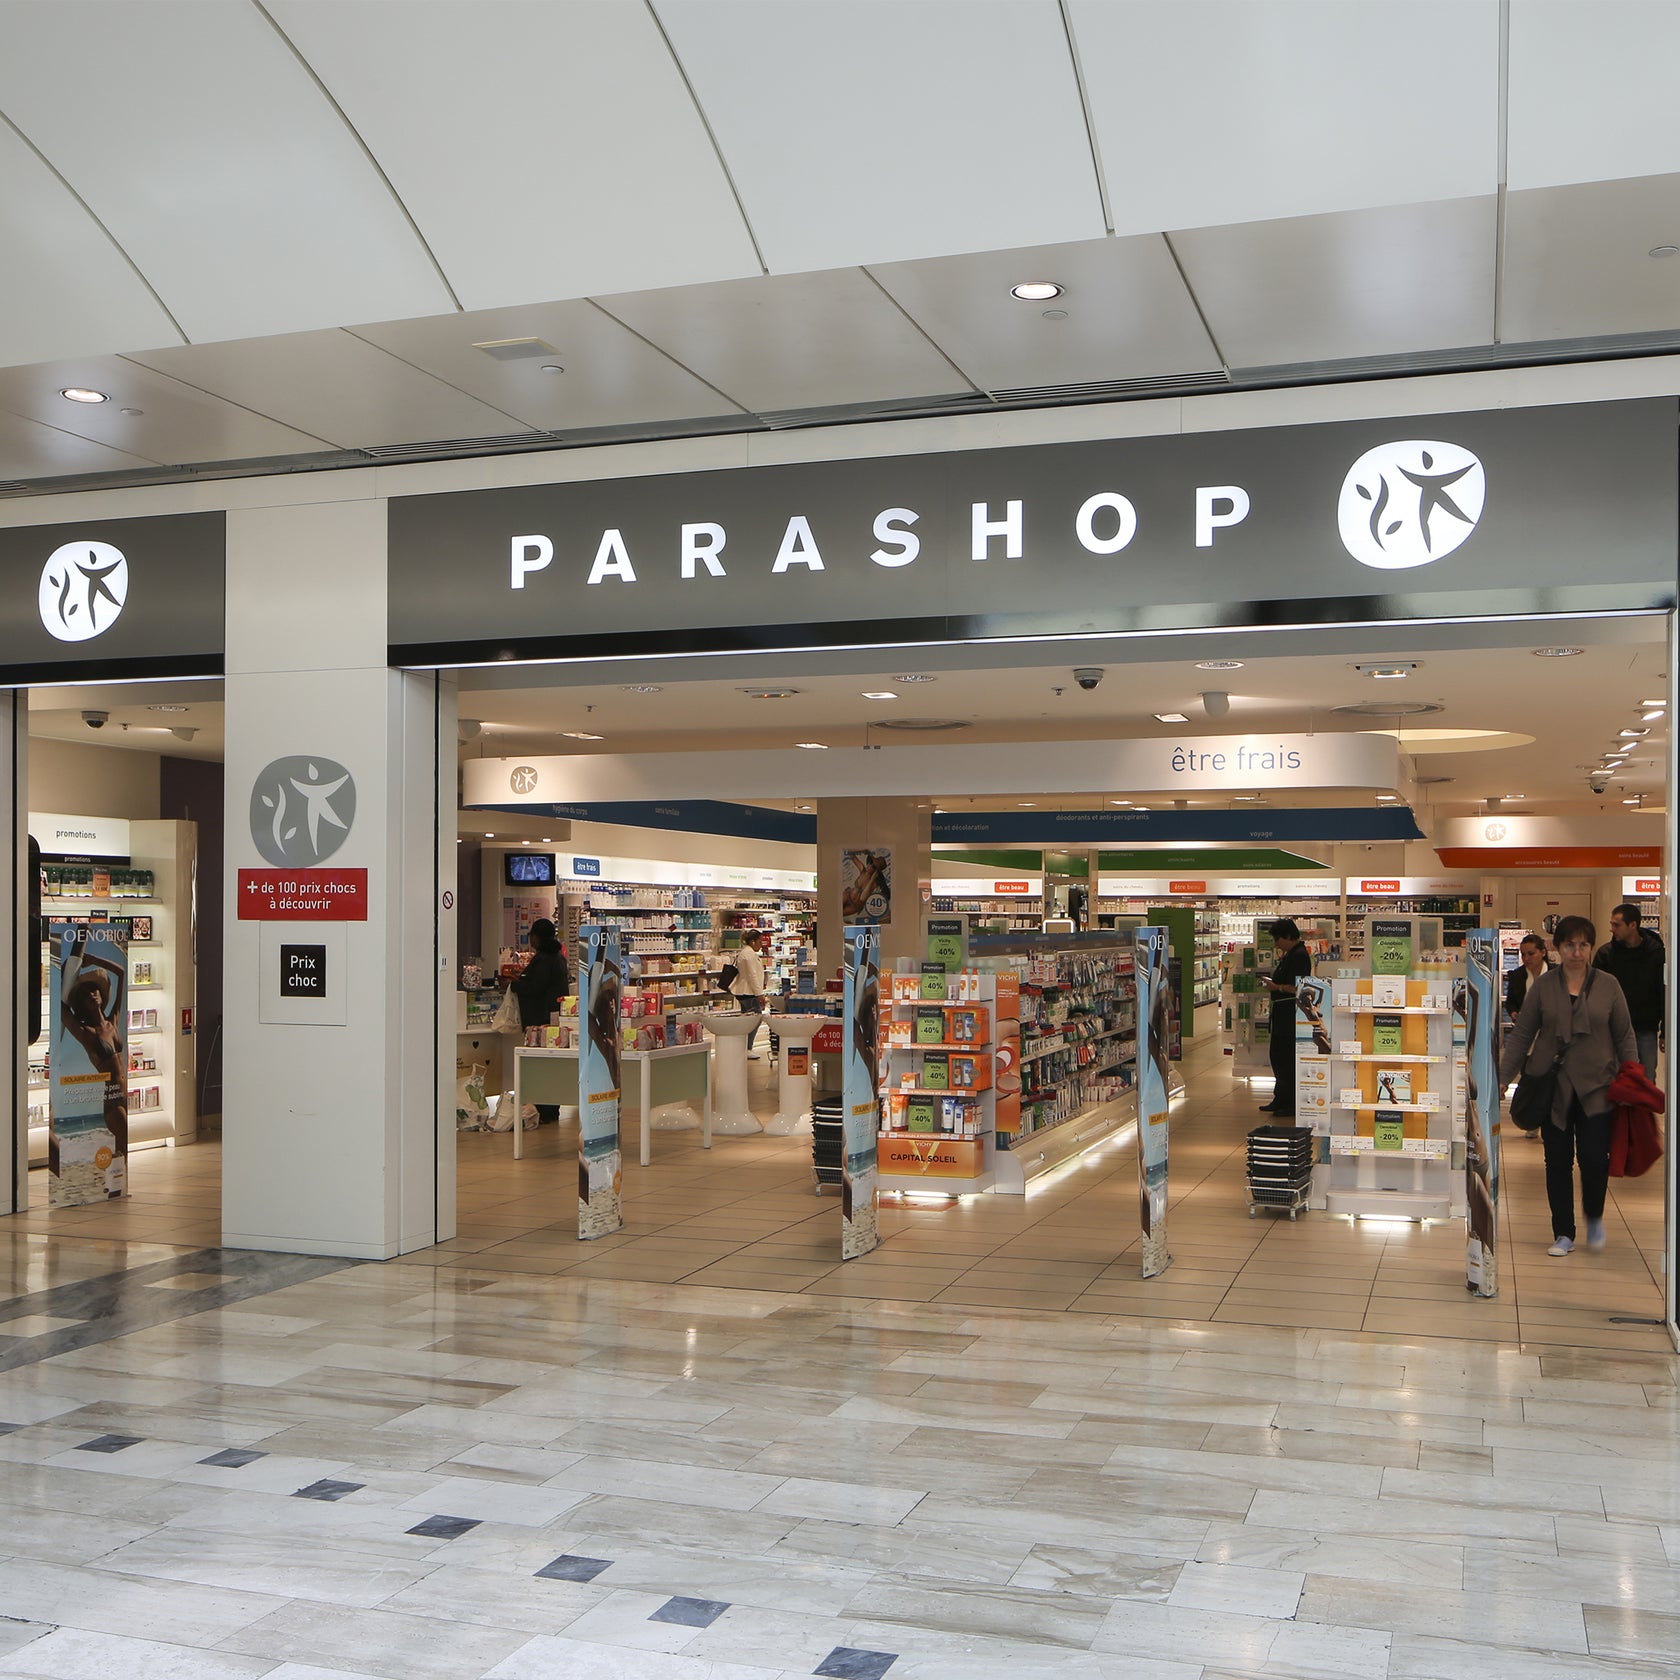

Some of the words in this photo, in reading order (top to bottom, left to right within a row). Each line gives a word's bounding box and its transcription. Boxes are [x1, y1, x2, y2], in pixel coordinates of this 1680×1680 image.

[511, 485, 1250, 589] PARASHOP
[1171, 747, 1226, 772] être
[1237, 745, 1301, 770] frais
[1099, 814, 1150, 822] anti-perspirants
[56, 830, 96, 840] promotions
[577, 862, 586, 871] être
[586, 862, 596, 872] frais
[261, 882, 274, 893] de
[278, 882, 296, 893] 100
[300, 882, 321, 896] prix
[324, 882, 356, 893] chocs
[270, 897, 276, 909] à
[279, 897, 331, 909] découvrir
[290, 955, 316, 968] Prix
[1380, 952, 1404, 960] -20%
[288, 973, 317, 987] choc
[890, 1153, 925, 1162] CAPITAL
[928, 1155, 957, 1163] SOLEIL
